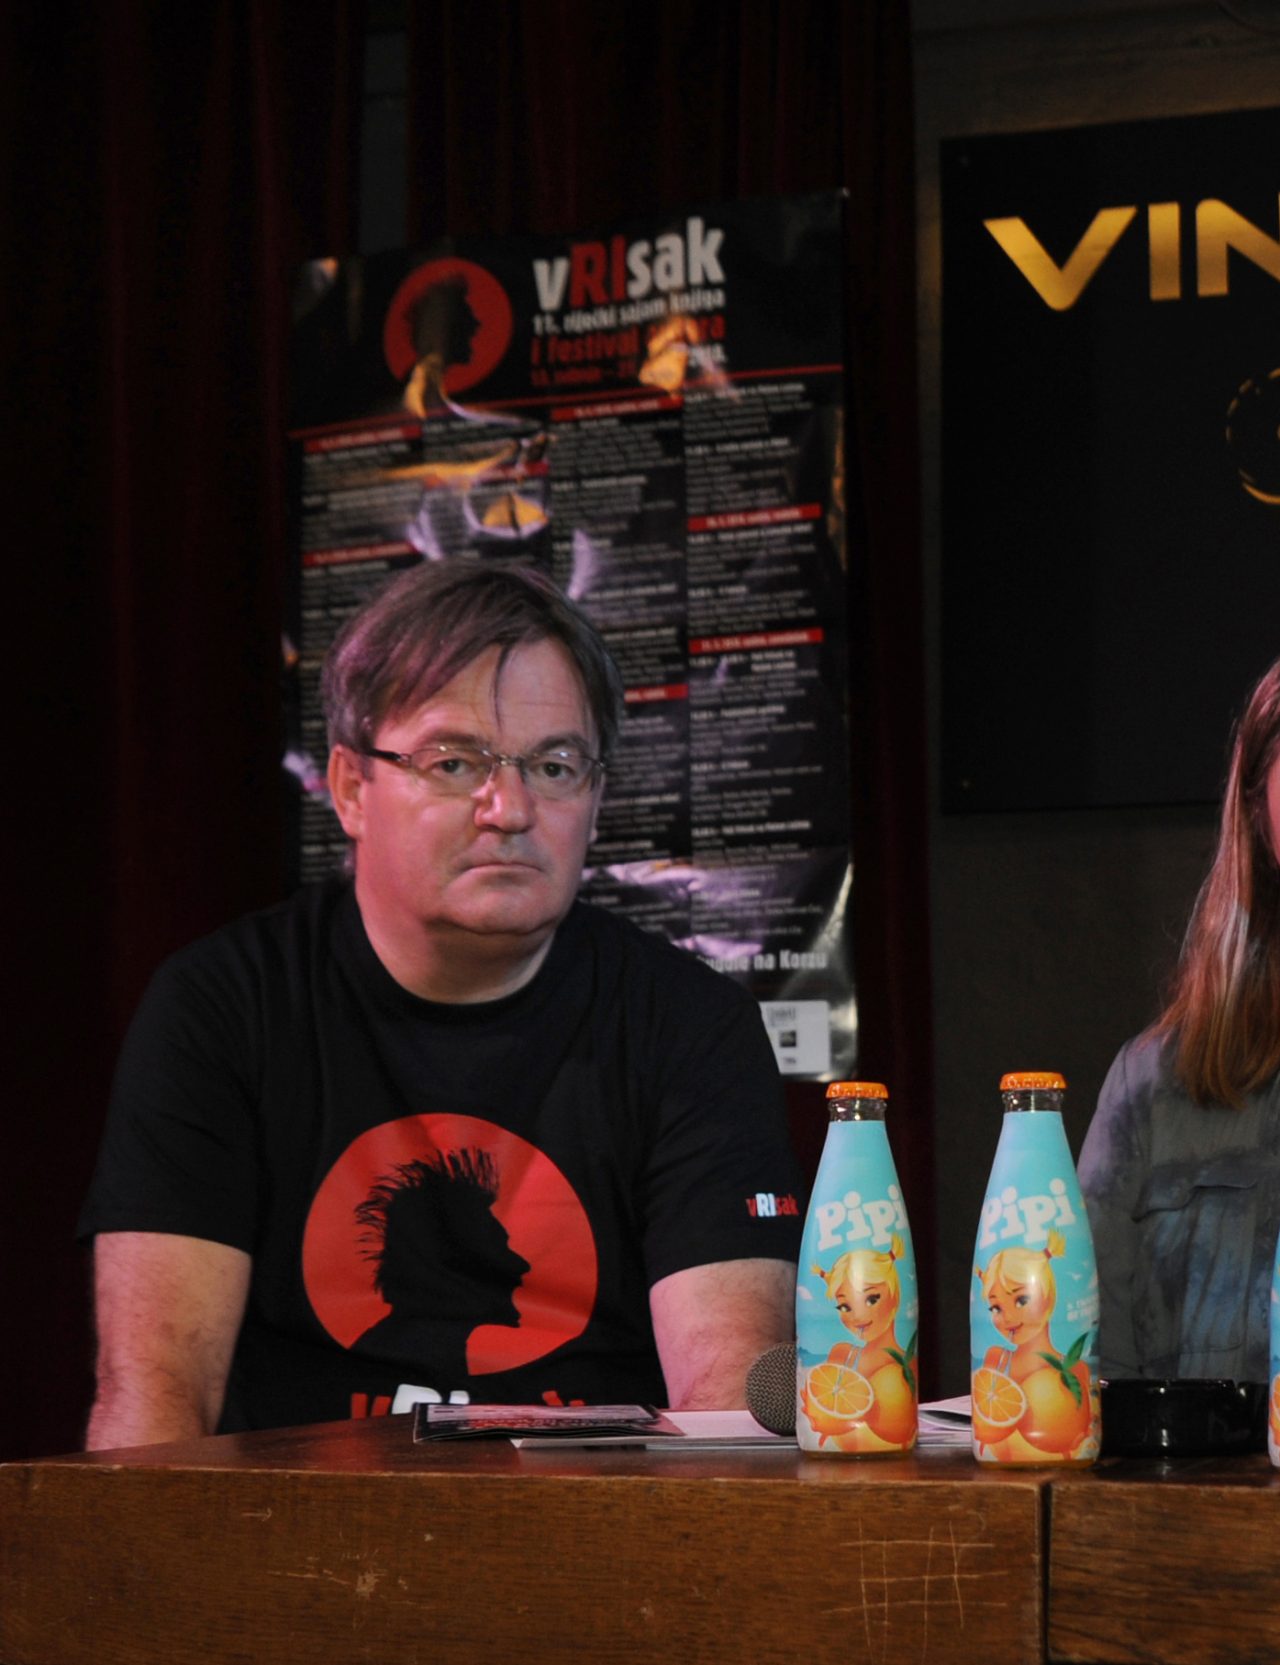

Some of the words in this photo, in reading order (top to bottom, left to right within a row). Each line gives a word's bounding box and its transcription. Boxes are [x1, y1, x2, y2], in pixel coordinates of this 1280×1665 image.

[532, 215, 727, 312] vRIsak
[547, 326, 640, 363] festival
[745, 1192, 800, 1218] vRIsak
